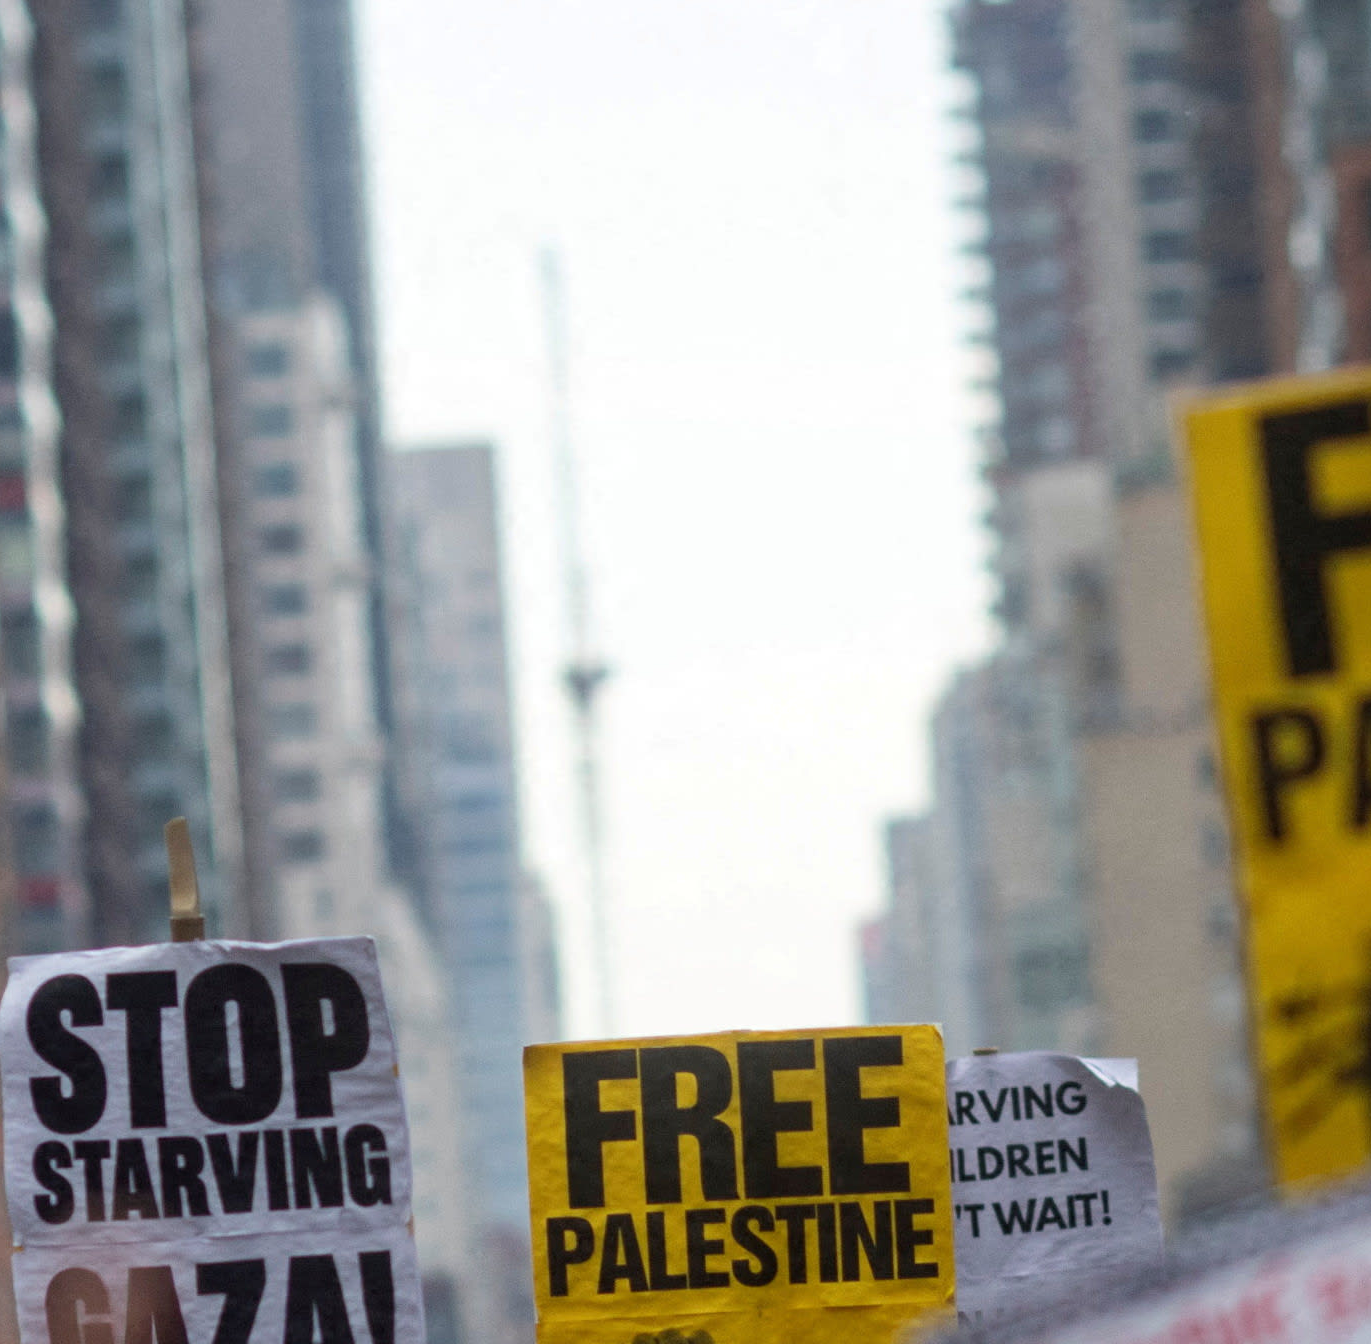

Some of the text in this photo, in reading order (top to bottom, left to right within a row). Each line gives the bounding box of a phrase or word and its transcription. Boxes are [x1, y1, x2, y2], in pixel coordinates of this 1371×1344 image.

[26, 962, 370, 1134] STOP
[561, 1035, 911, 1209] FREE
[33, 1124, 392, 1224] STARVING
[992, 1190, 1112, 1235] WAIT!
[545, 1198, 939, 1298] PALESTINE
